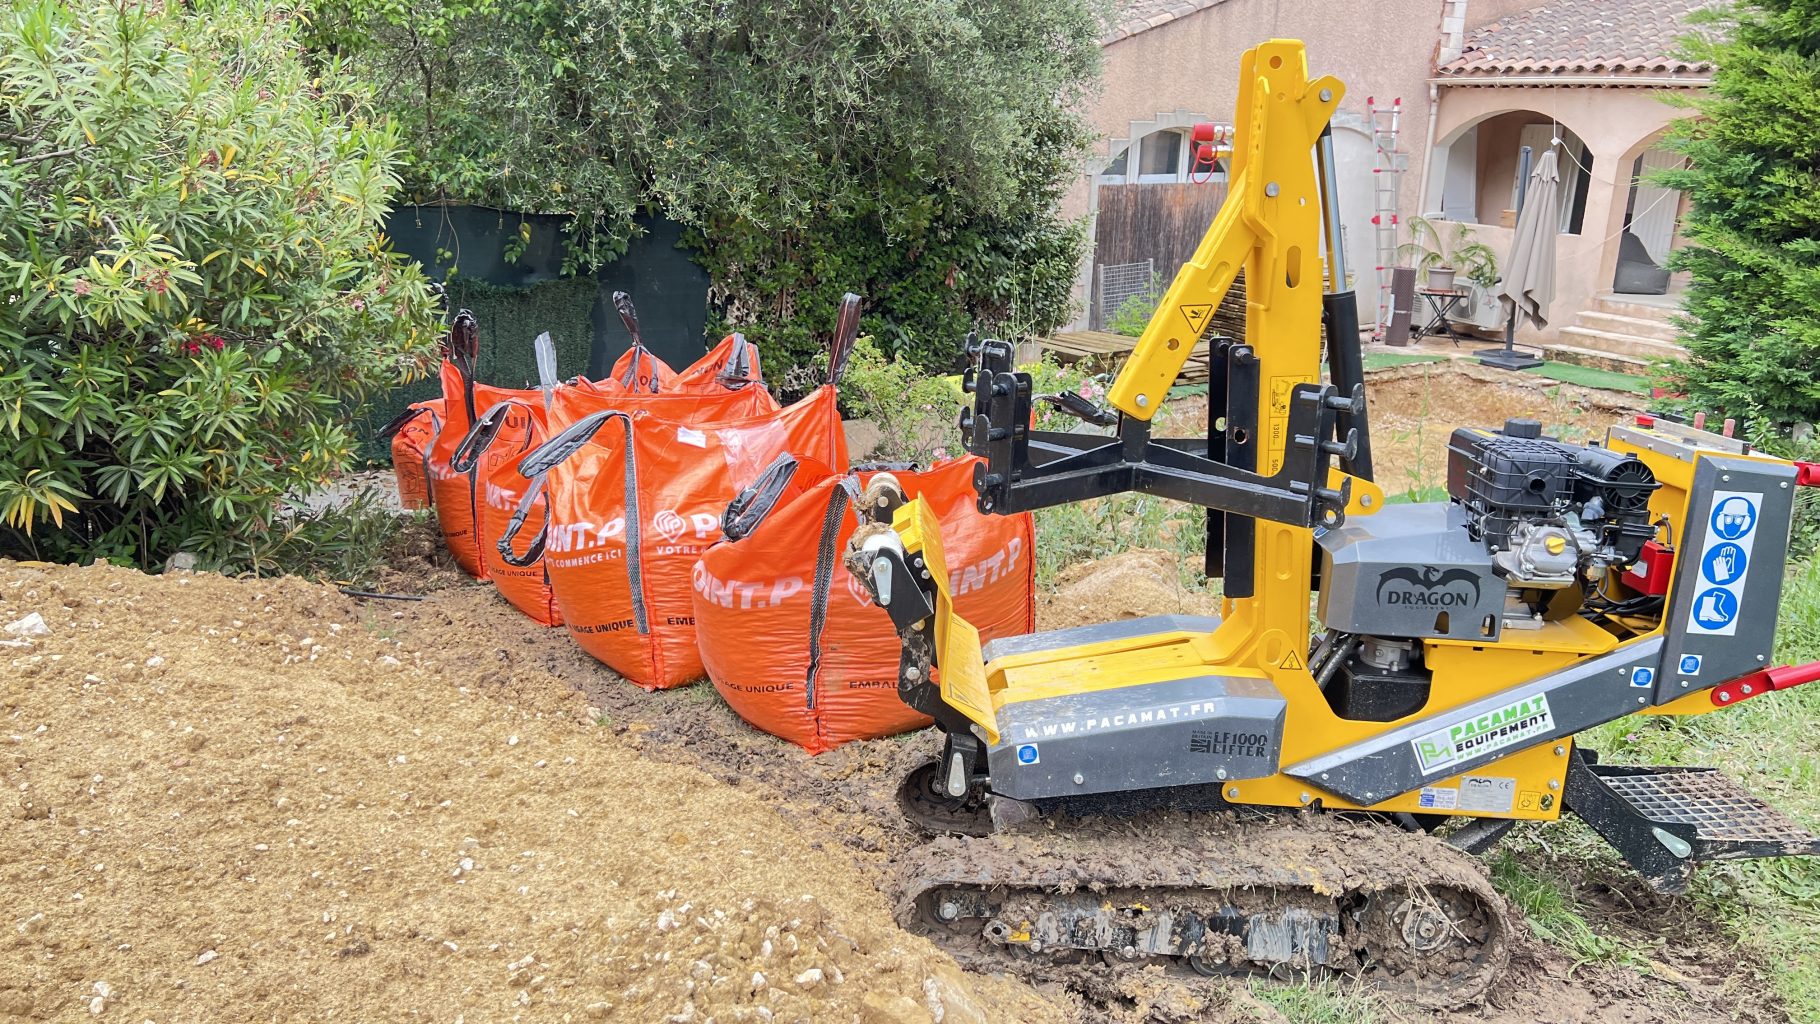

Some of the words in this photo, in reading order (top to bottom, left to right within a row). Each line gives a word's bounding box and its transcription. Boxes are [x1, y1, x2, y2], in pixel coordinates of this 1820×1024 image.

[656, 545, 697, 556] VOTRE
[555, 552, 603, 568] COMMENCE
[606, 549, 622, 561] ICI
[950, 537, 1022, 597] INT.P
[1387, 591, 1468, 606] DRAGON
[595, 619, 634, 633] UNIQUE
[745, 681, 795, 693] UNIQUE
[850, 681, 898, 689] EMBAL
[1449, 696, 1544, 741] PACAMAT
[1456, 713, 1547, 752] EQUIPEMENT
[1212, 743, 1265, 757] LIFTER
